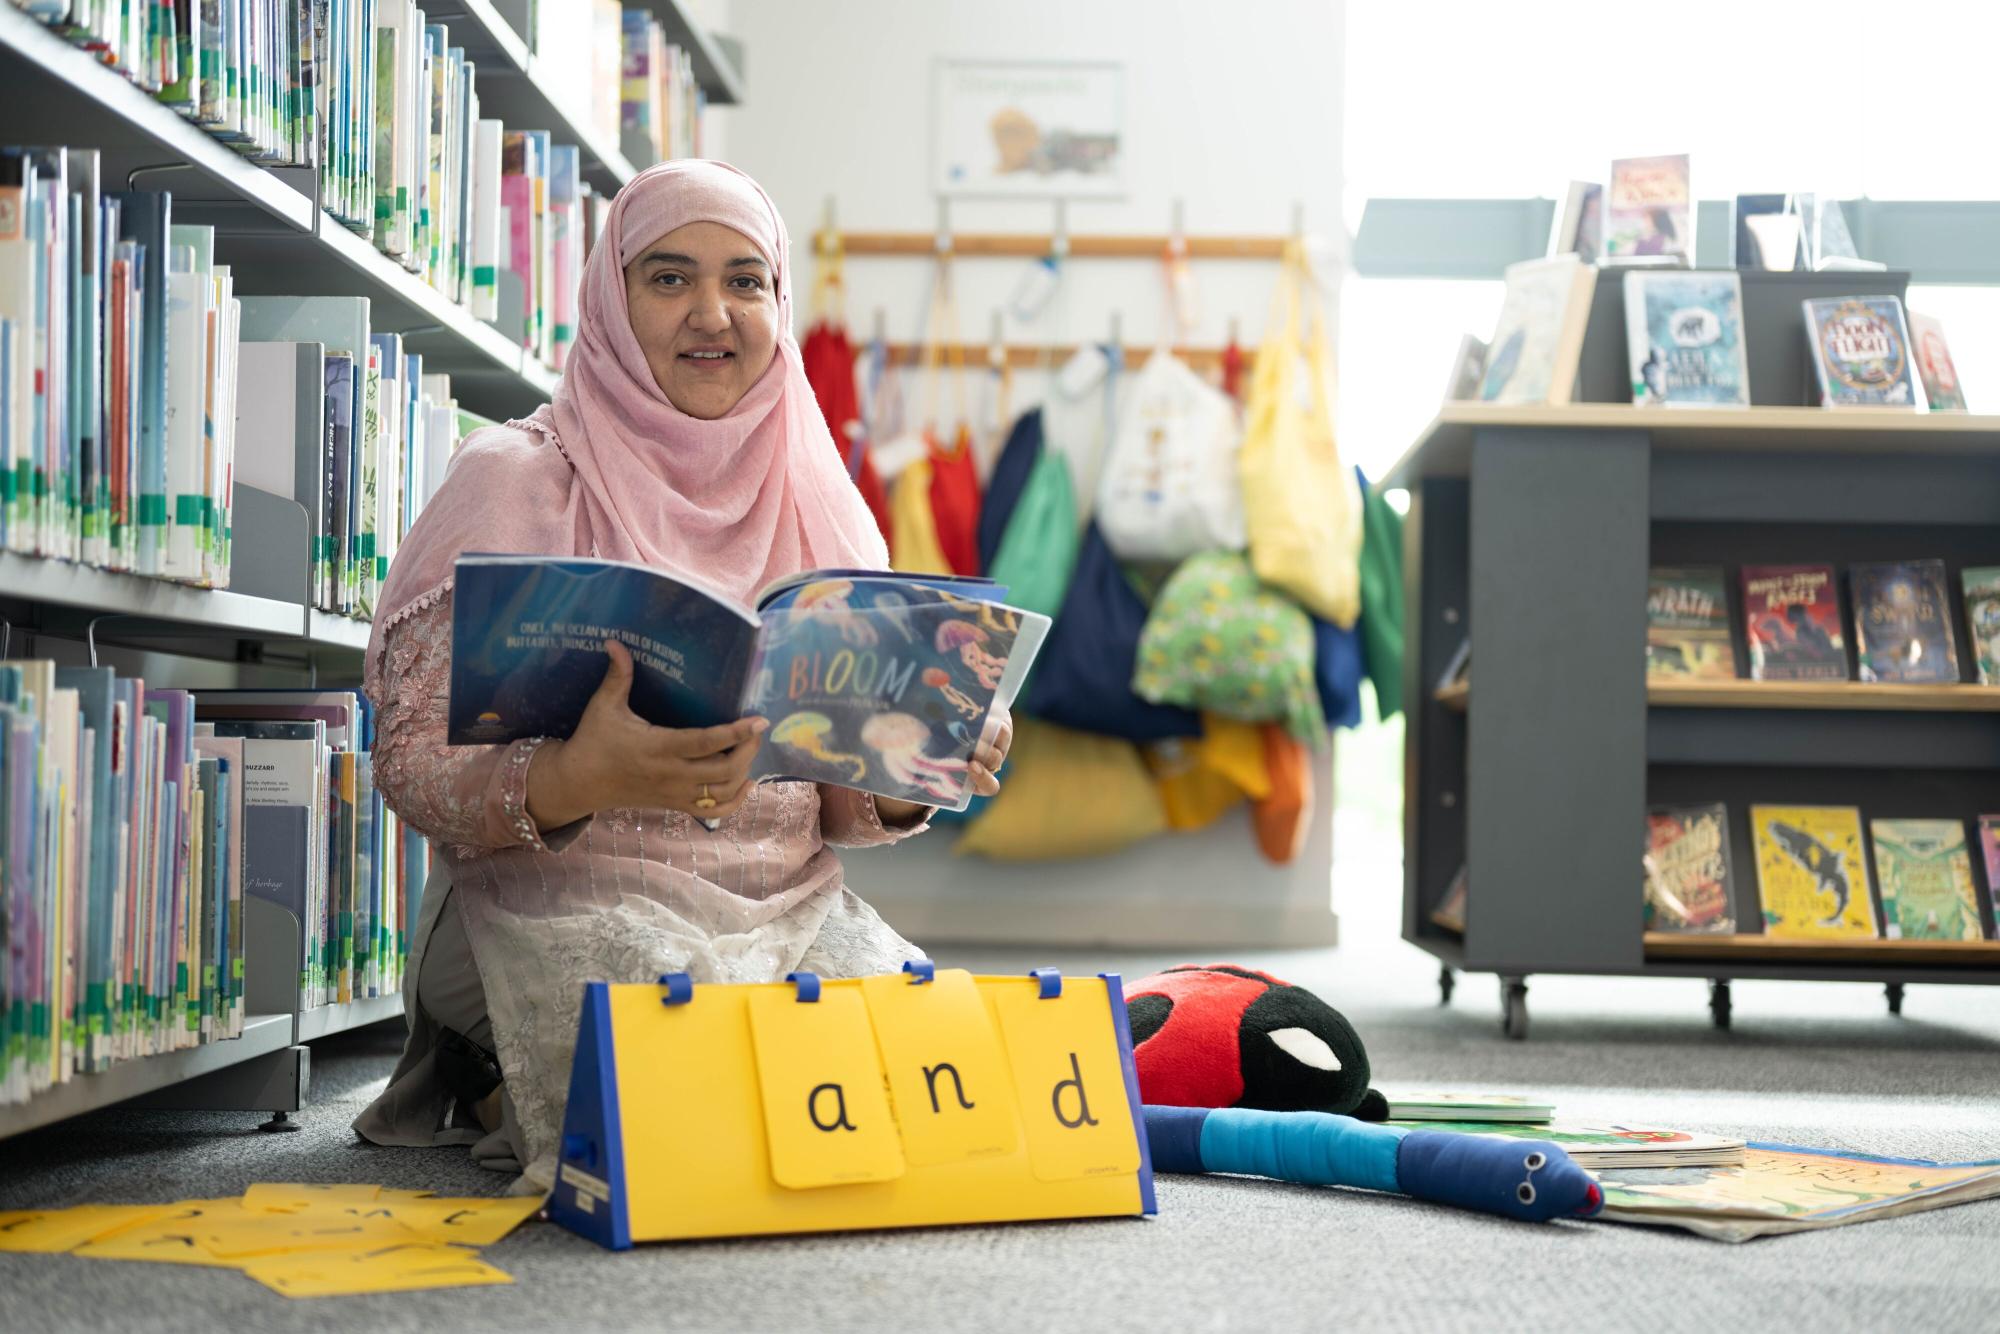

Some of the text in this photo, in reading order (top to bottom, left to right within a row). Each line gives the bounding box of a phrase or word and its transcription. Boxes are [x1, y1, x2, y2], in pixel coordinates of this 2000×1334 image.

[507, 636, 526, 649] BUT
[561, 637, 594, 652] THINGS
[567, 623, 598, 638] OCEAN
[600, 627, 621, 642] WAS
[622, 630, 640, 647] FULL
[641, 636, 651, 649] OF
[788, 648, 917, 703] BLOOM
[808, 1052, 1099, 1132] a n d
